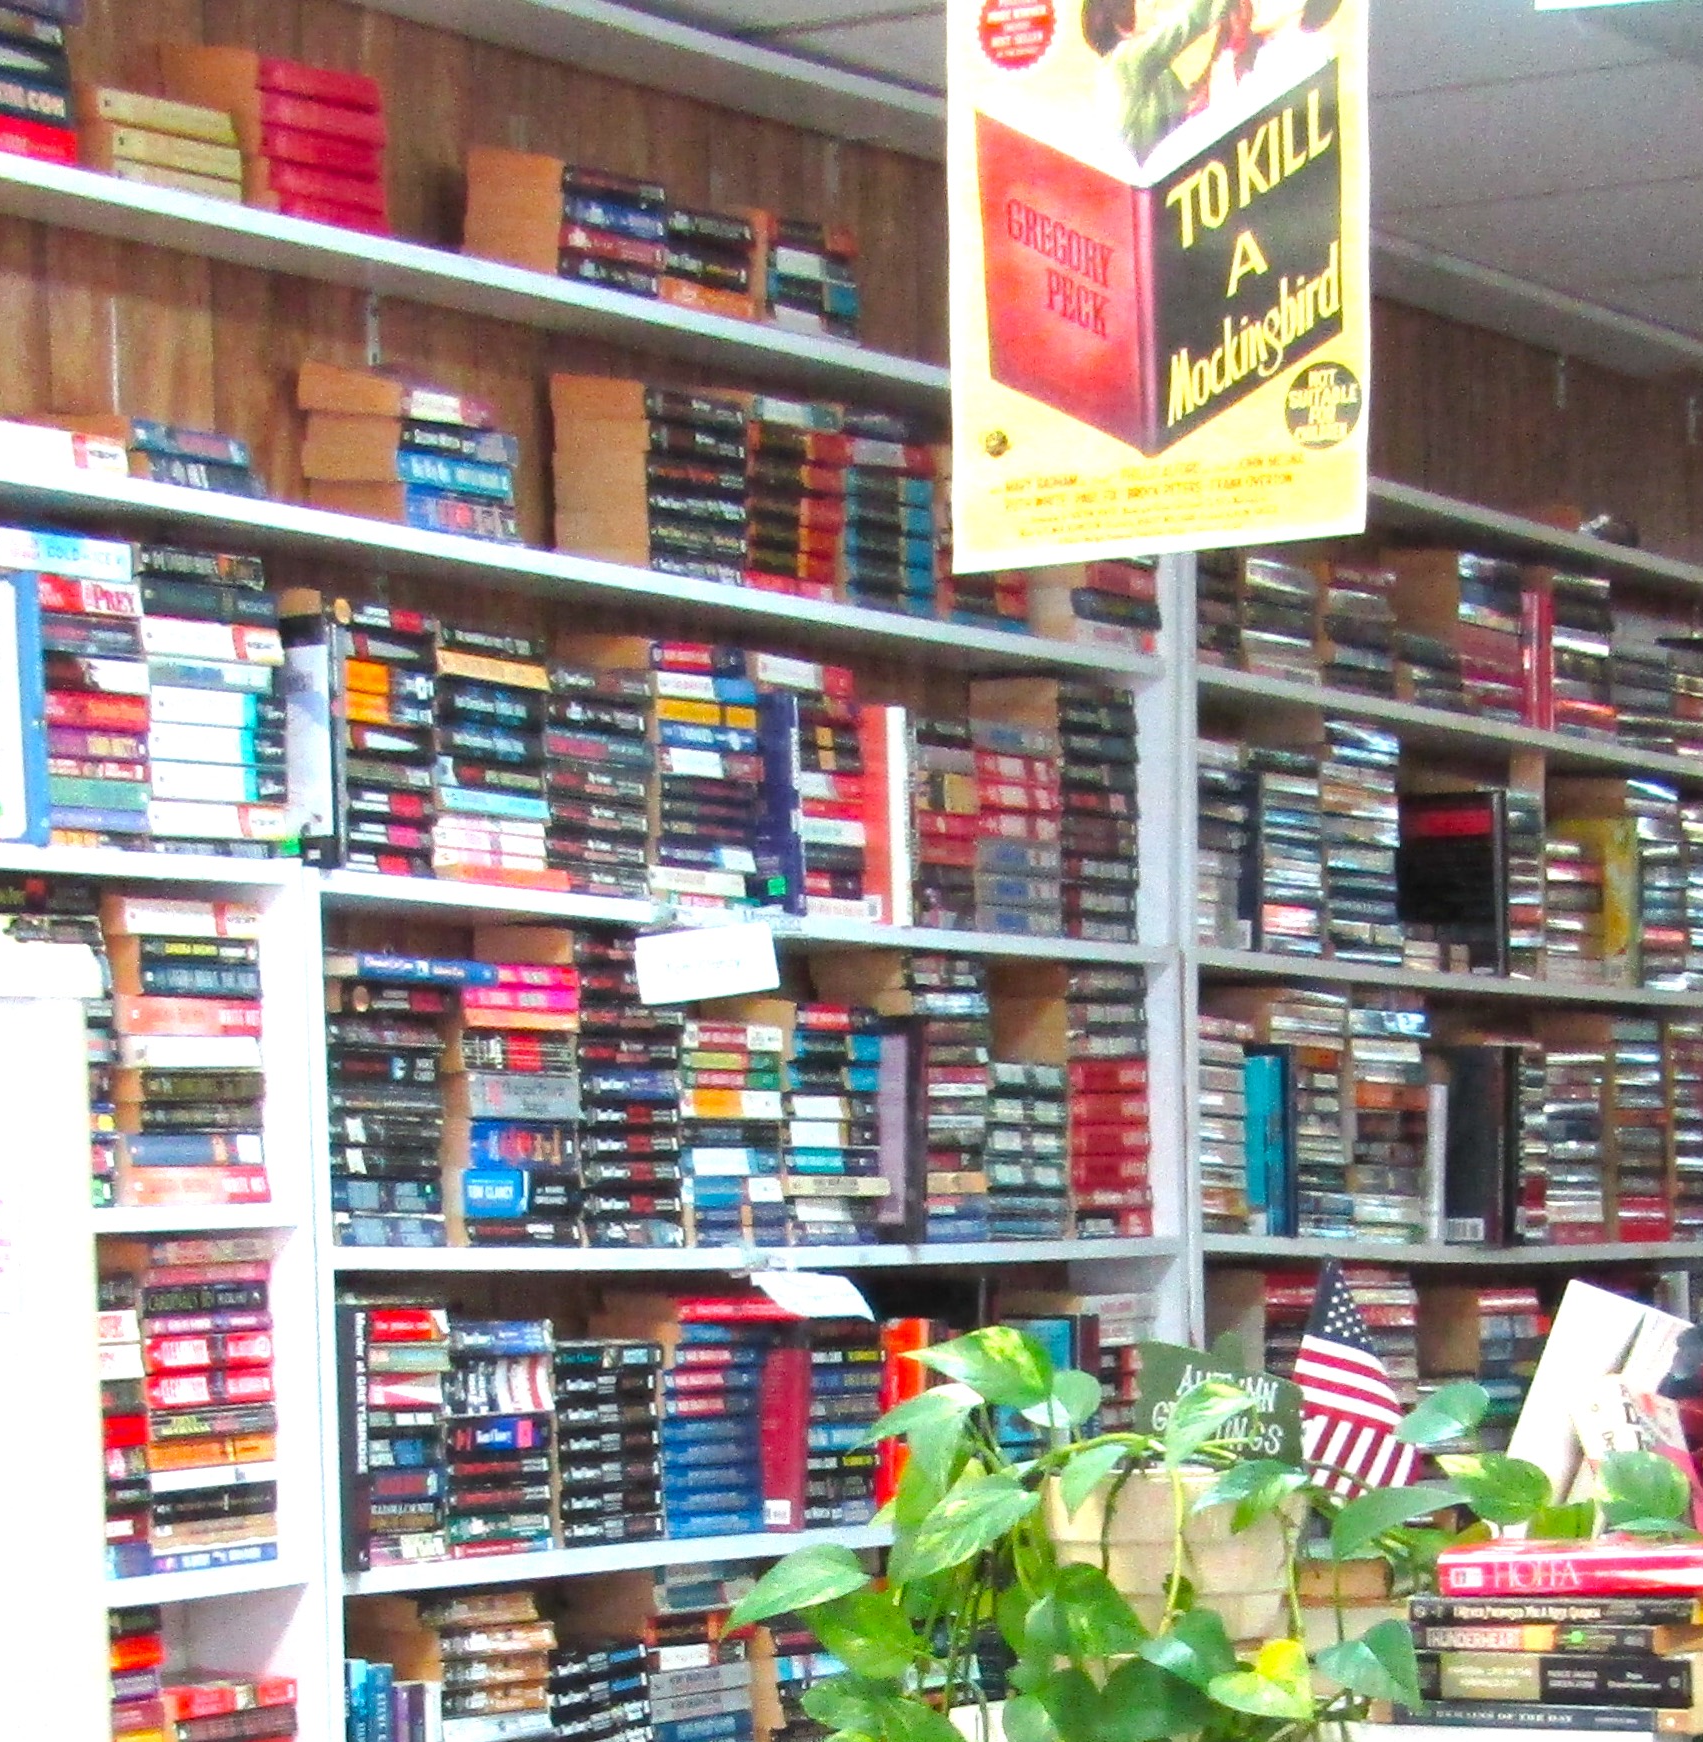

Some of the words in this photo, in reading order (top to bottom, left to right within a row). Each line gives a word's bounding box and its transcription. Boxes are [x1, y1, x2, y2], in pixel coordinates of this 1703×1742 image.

[1166, 158, 1229, 249] TO
[1236, 88, 1335, 210] KILL
[1006, 197, 1116, 289] GREGORY
[1225, 230, 1269, 298] A
[1045, 265, 1109, 339] PECK
[1167, 240, 1342, 428] Mockingbird
[1288, 383, 1360, 408] SUITABLE
[354, 1312, 369, 1358] Murder
[355, 1360, 369, 1373] at
[355, 1375, 370, 1474] GREYSBRIDGE
[1493, 1559, 1583, 1588] HOFFA
[1497, 1712, 1514, 1722] OF
[1517, 1712, 1544, 1723] THE
[1547, 1714, 1574, 1724] DAY
